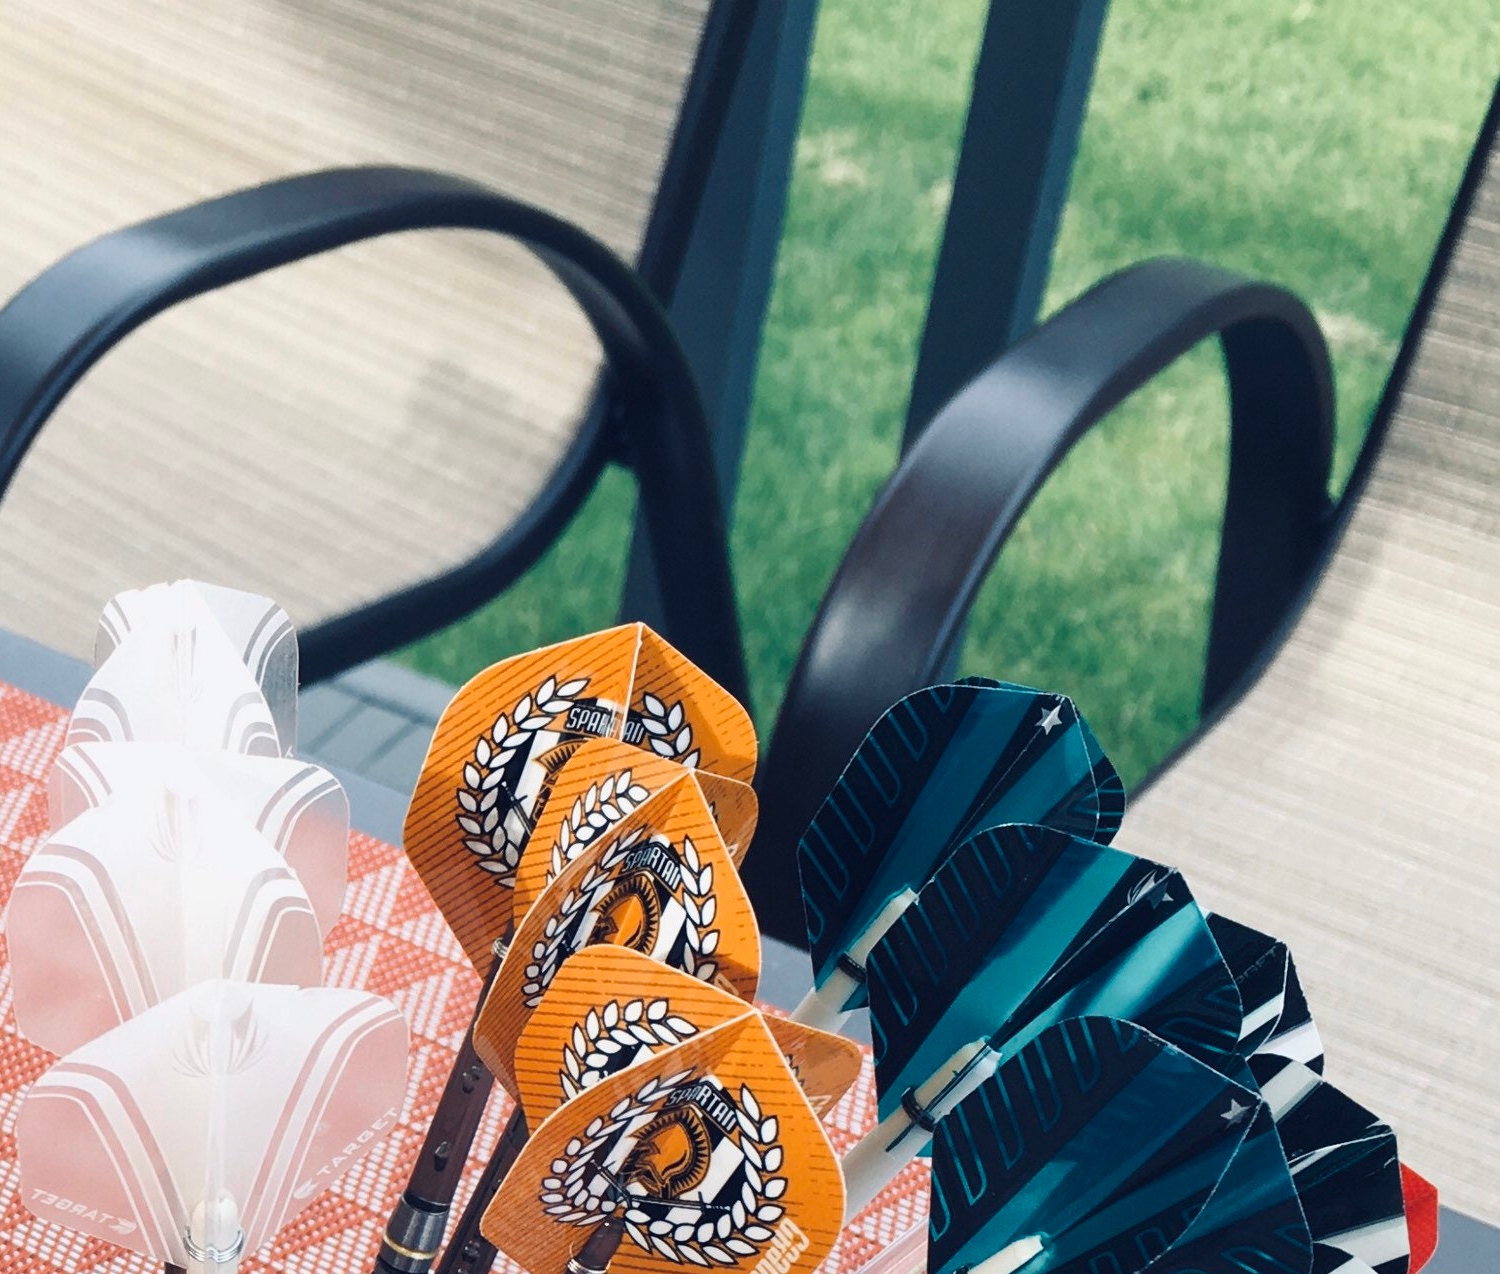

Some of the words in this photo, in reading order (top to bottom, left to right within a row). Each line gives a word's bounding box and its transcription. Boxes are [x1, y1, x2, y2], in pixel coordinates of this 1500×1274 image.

[566, 707, 645, 743] SPAAN
[623, 846, 683, 891] SPARTAN
[666, 1084, 737, 1132] SPARTAN
[316, 1106, 398, 1176] TARGET
